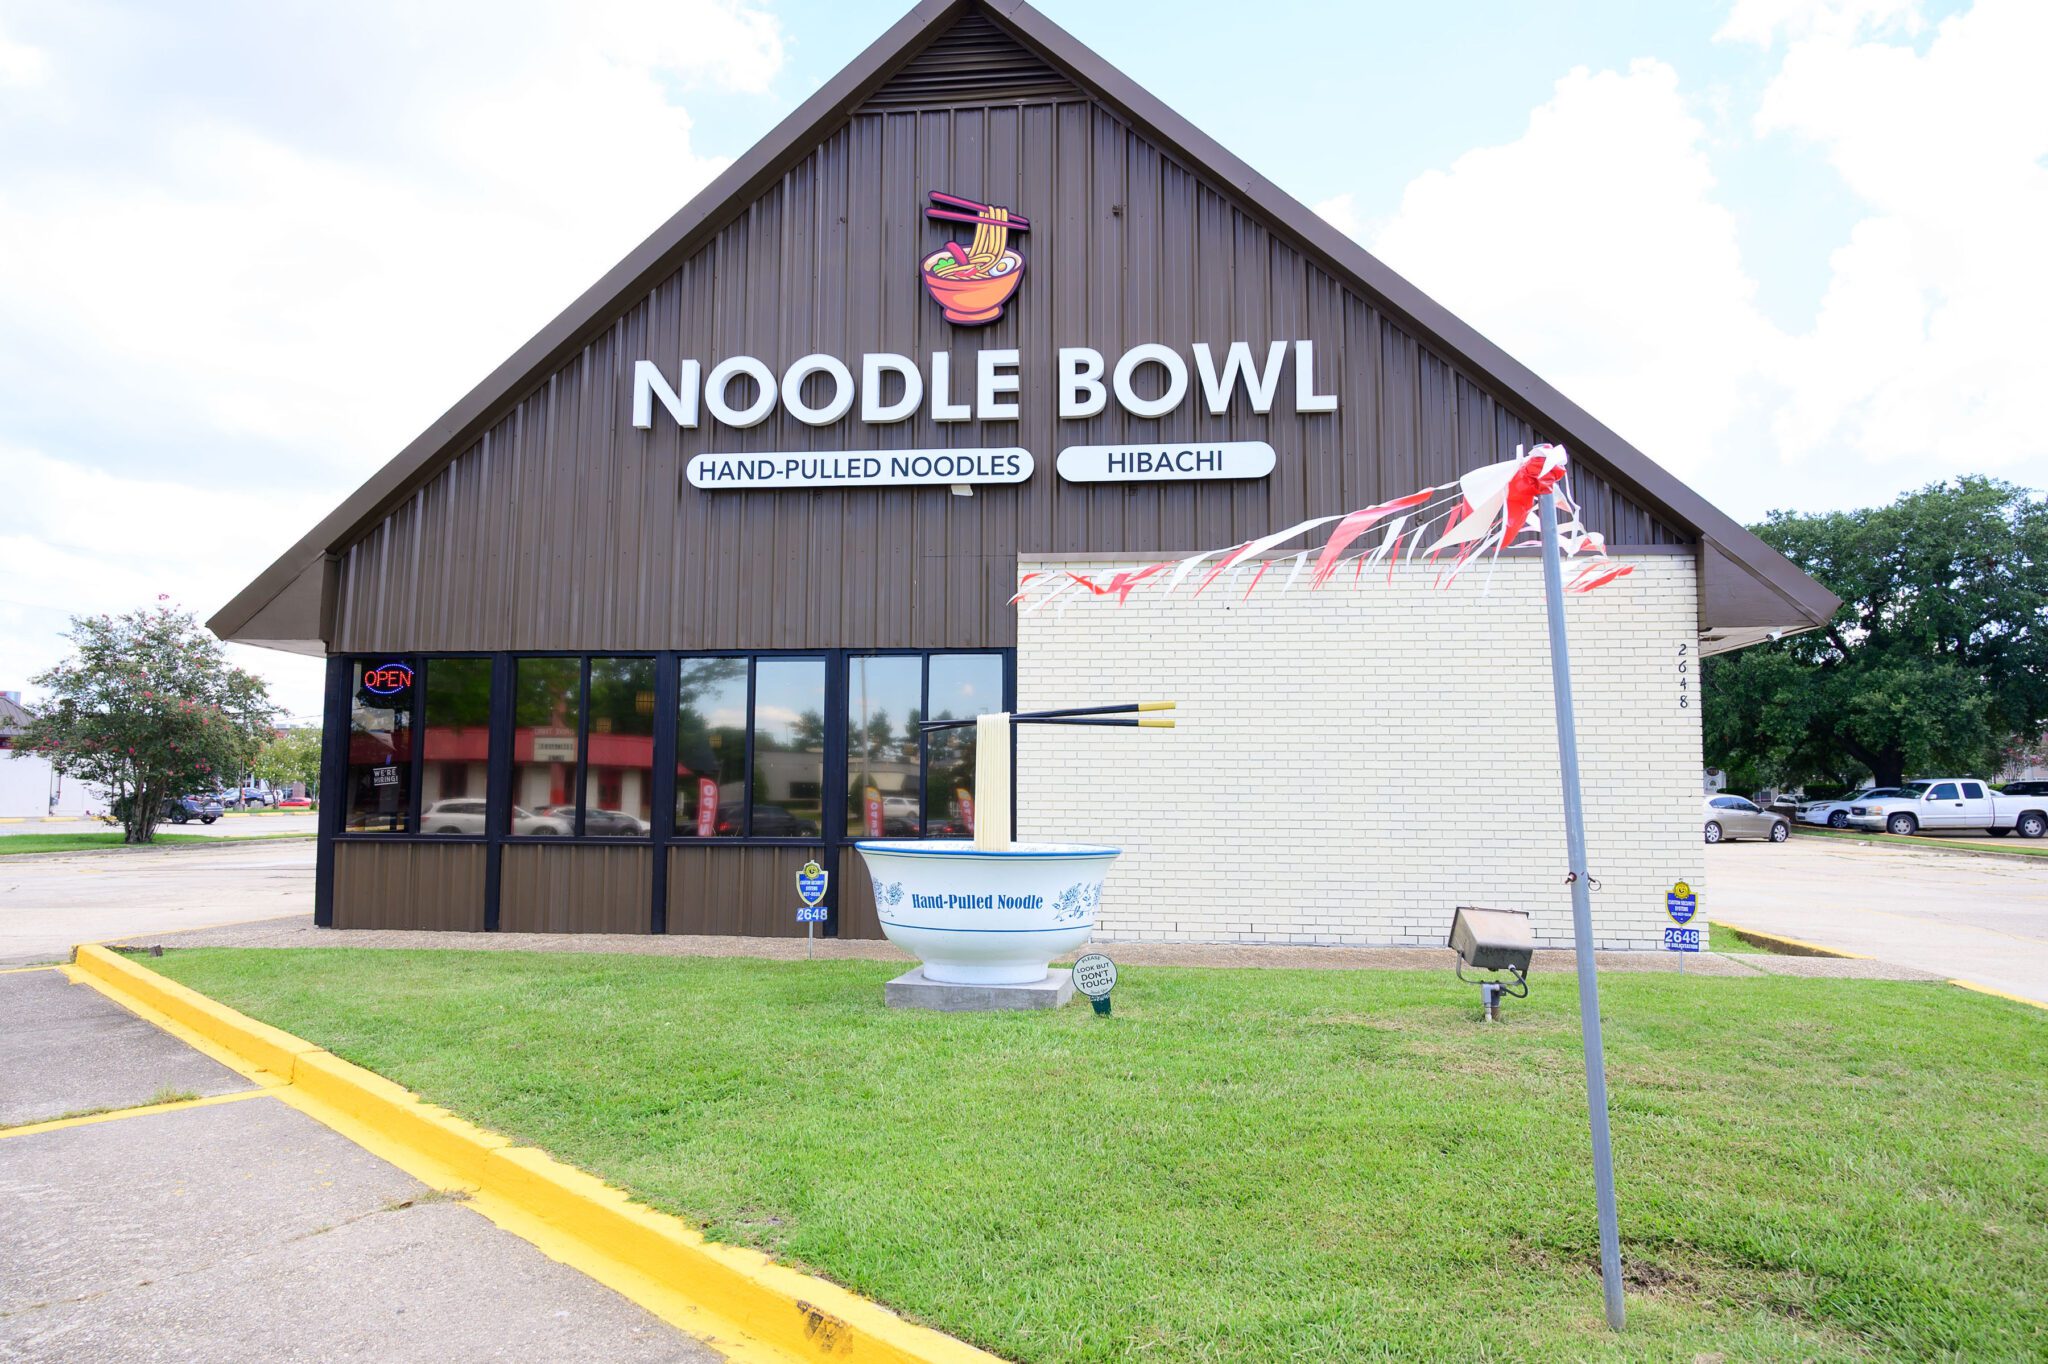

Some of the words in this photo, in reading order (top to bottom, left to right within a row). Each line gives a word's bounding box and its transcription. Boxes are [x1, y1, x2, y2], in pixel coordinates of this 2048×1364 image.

[633, 349, 1020, 429] NOODLE
[1059, 340, 1338, 419] BOWL
[699, 457, 881, 481] HAND-PULLED
[891, 454, 1020, 478] NOODLES
[1107, 450, 1222, 473] HIBACHI
[364, 670, 411, 687] OPEN
[1678, 643, 1688, 709] 2648
[373, 768, 396, 777] WE'RE
[912, 893, 993, 909] Hand-Pulled
[997, 894, 1043, 910] Noodle
[797, 908, 828, 921] 2648
[1665, 930, 1698, 944] 2648
[1082, 955, 1101, 963] PLEASE
[1077, 965, 1095, 973] LOOK
[1096, 962, 1109, 970] BUT
[1081, 970, 1108, 981] DON'T
[1081, 977, 1113, 989] TOUCH
